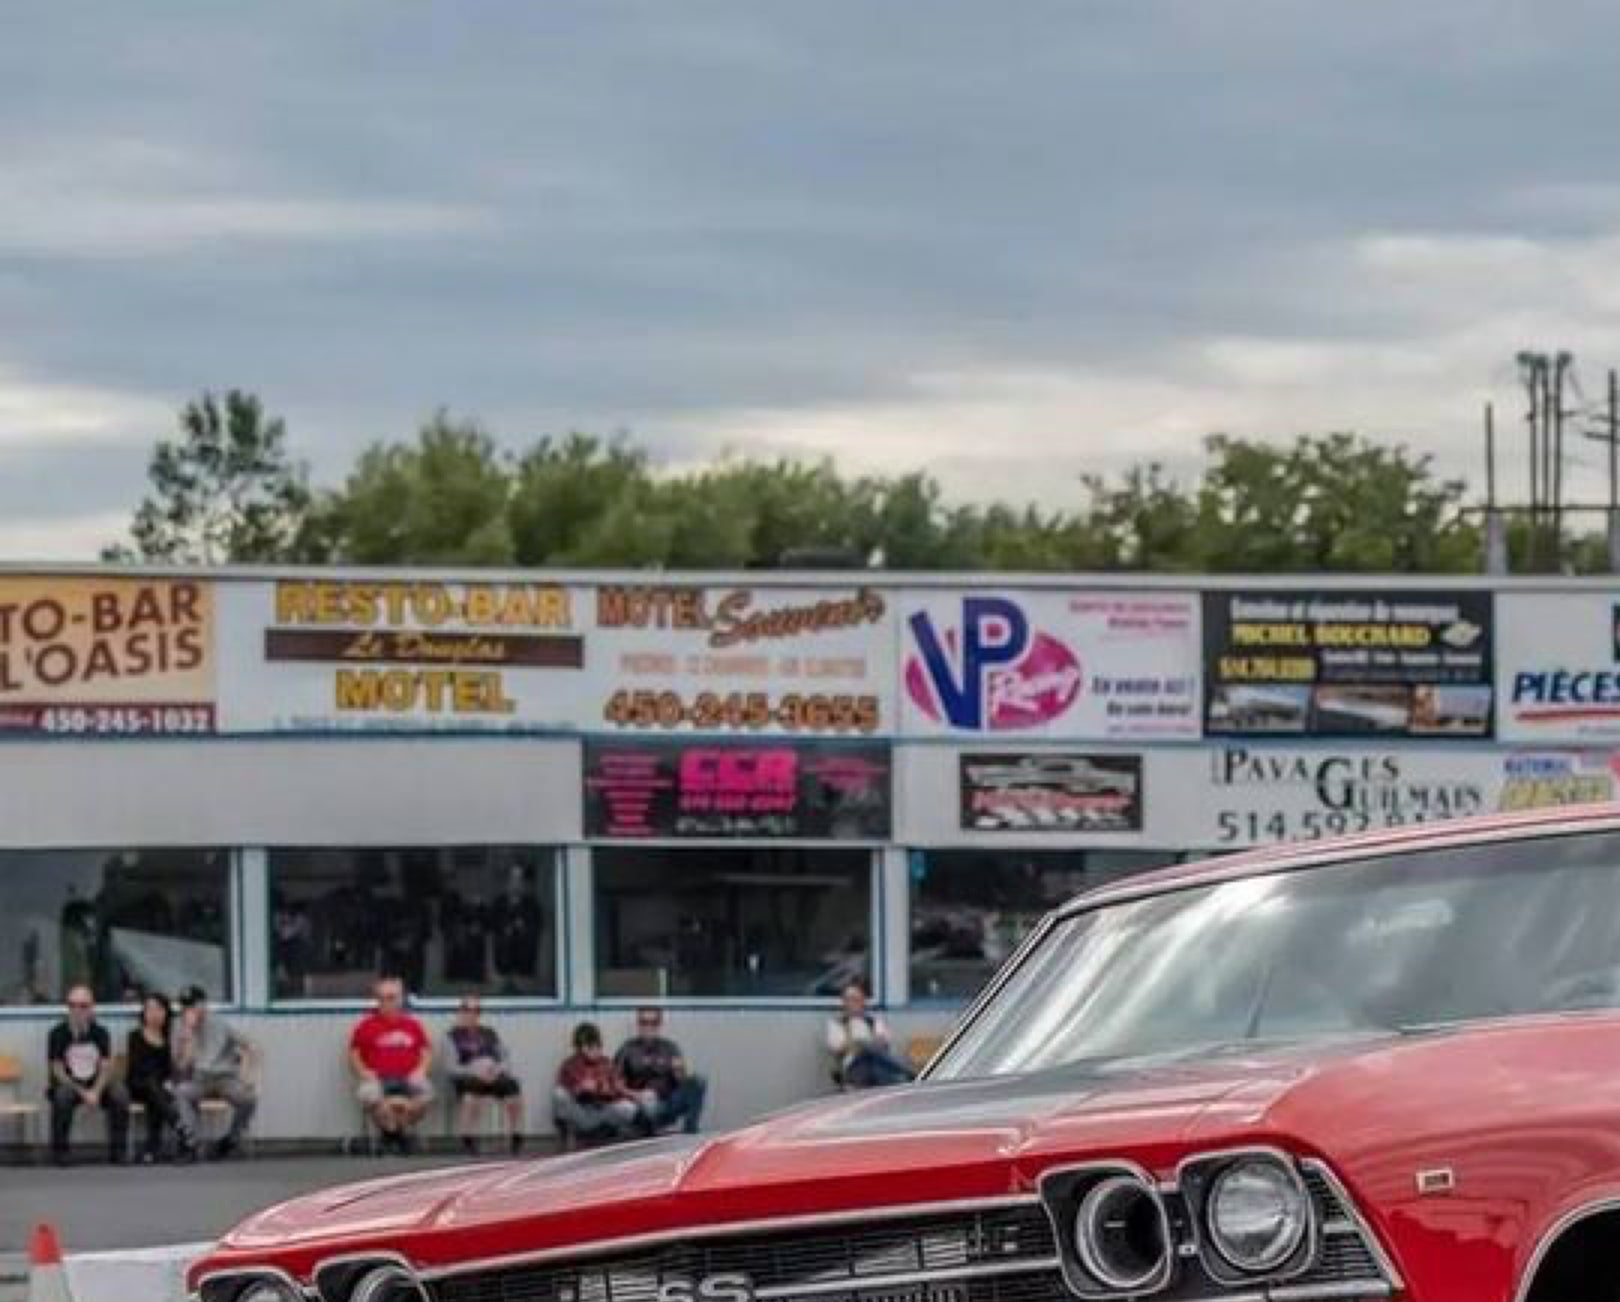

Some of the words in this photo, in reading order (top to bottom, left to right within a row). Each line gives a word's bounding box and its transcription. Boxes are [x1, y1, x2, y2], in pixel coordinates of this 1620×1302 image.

[275, 580, 570, 625] RESTO-BAR
[597, 585, 712, 629] MOTEL
[0, 626, 204, 691] L'OASIS
[909, 597, 1029, 731] VP
[335, 669, 516, 714] MOTEL
